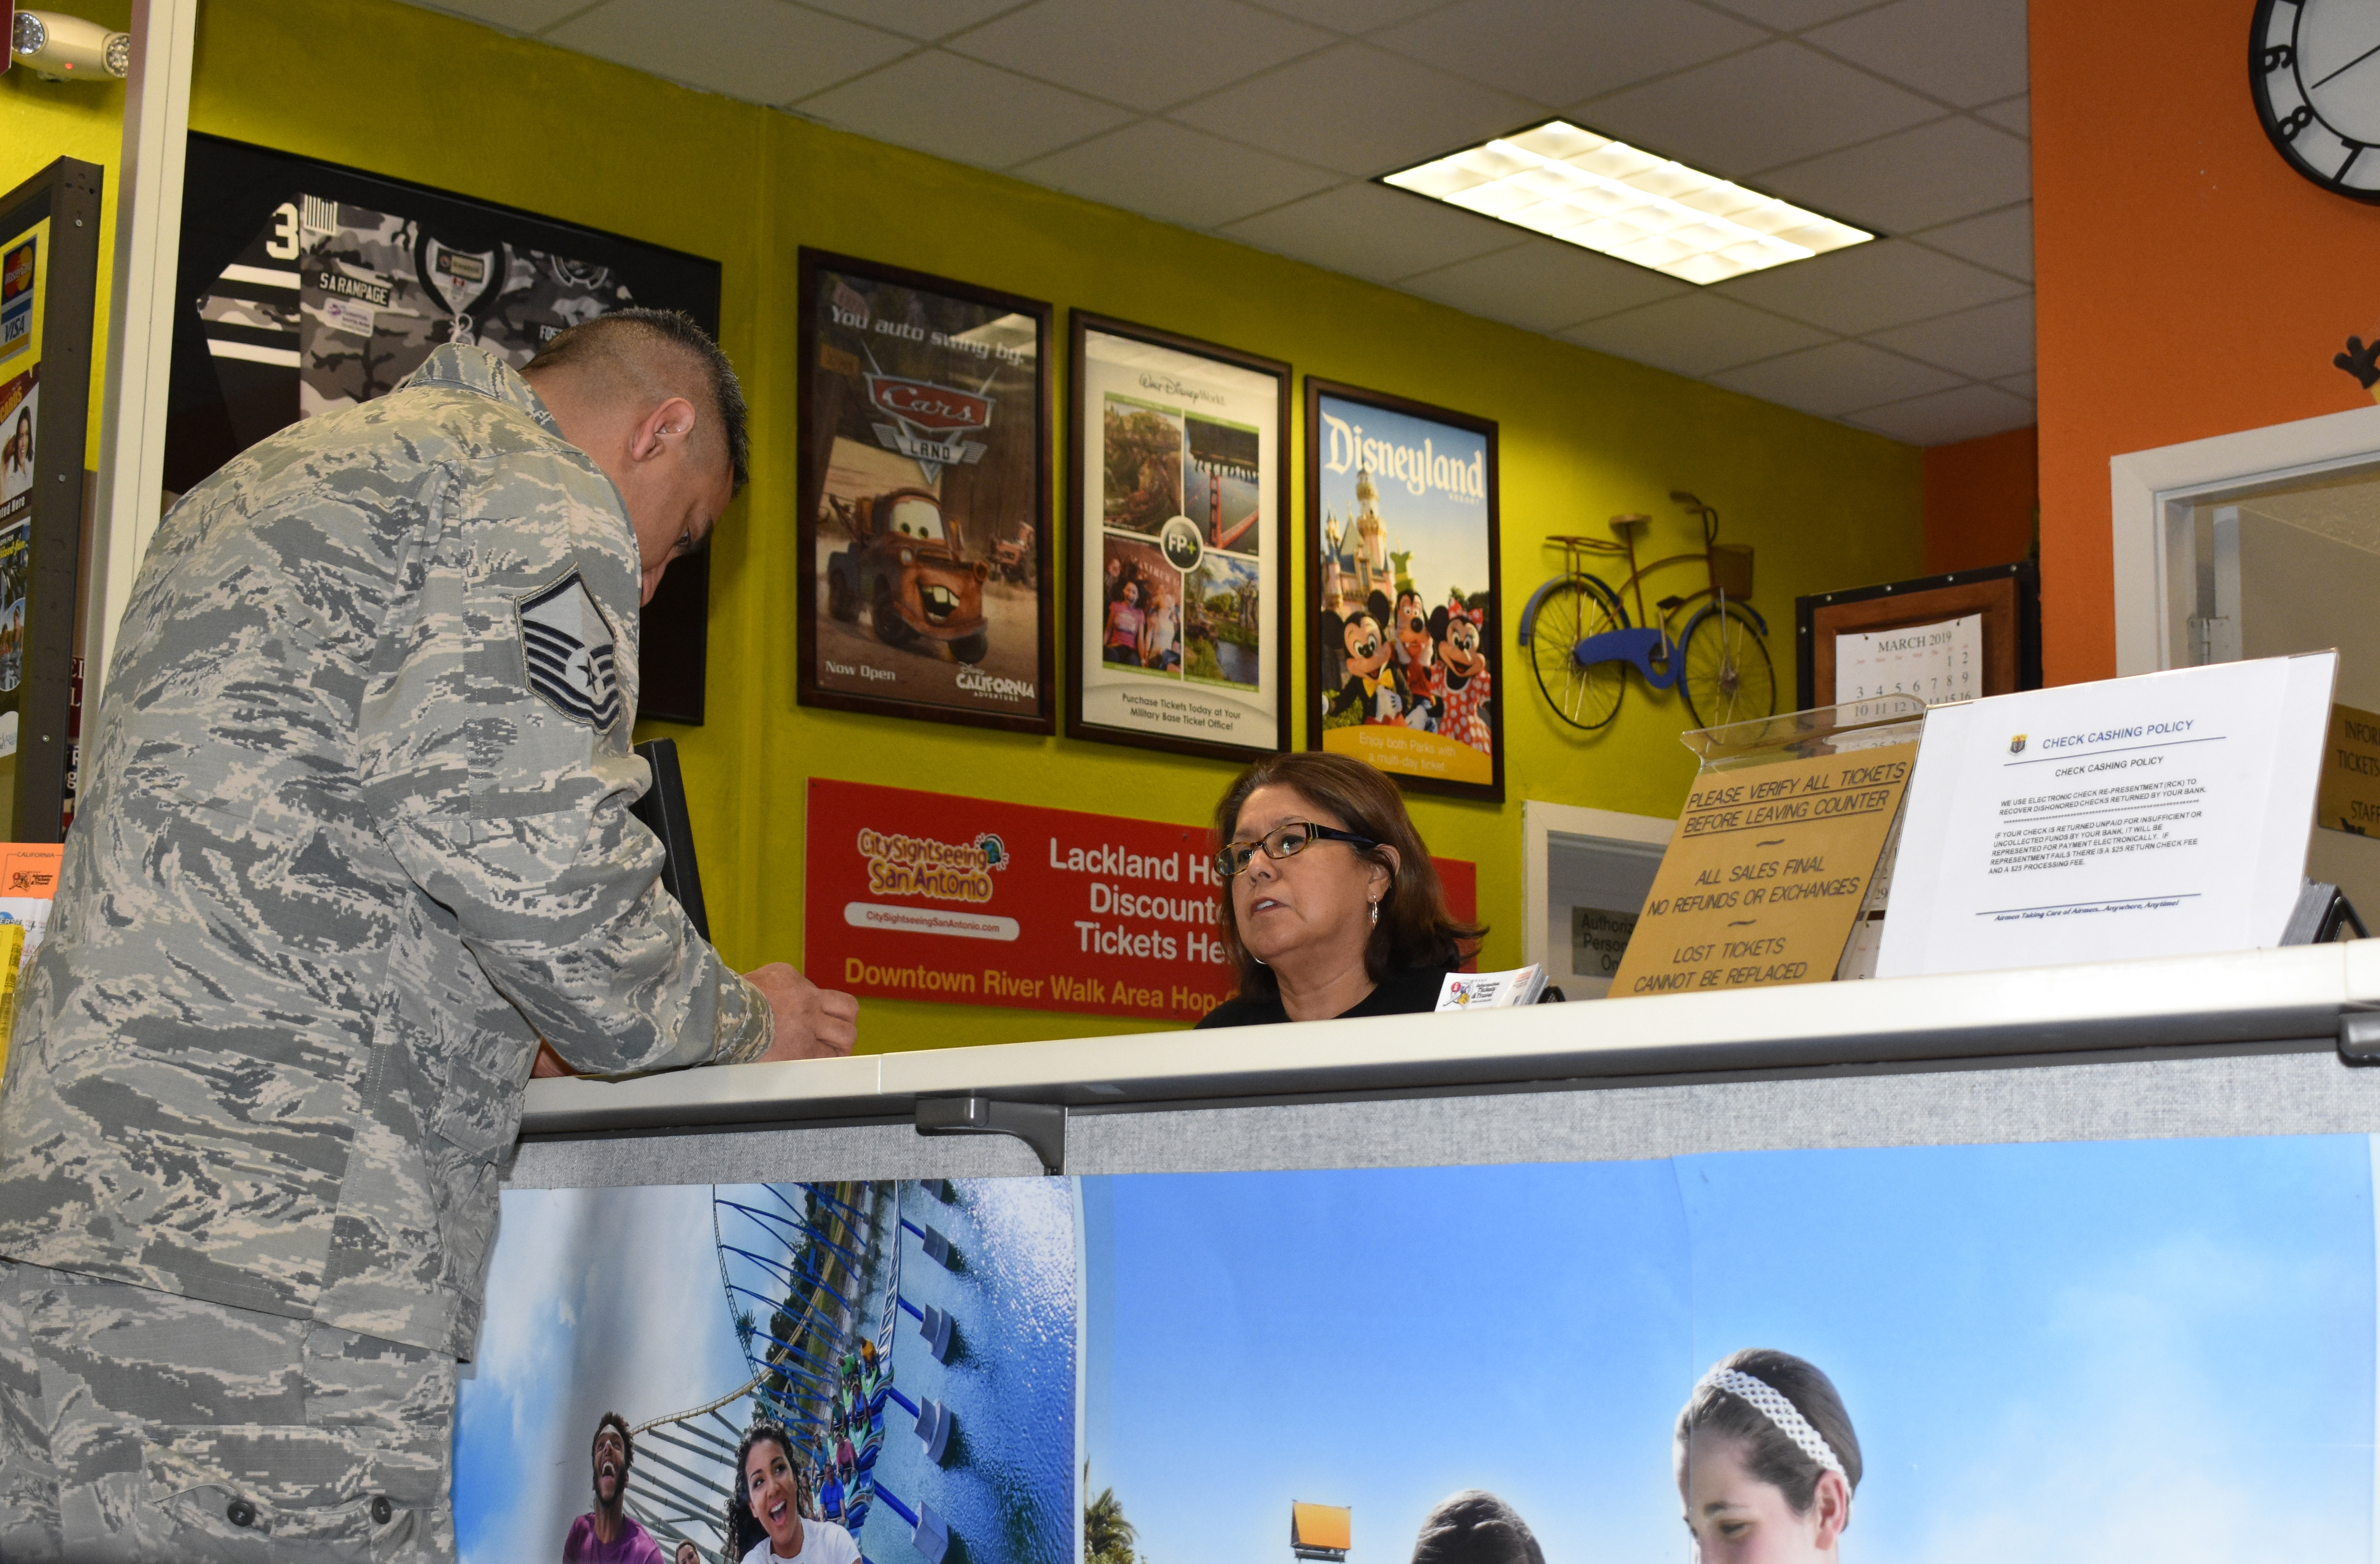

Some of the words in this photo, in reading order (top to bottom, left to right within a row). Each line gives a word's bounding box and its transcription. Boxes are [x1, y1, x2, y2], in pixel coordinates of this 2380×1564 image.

[2276, 106, 2313, 142] 8
[266, 202, 299, 260] 3
[5, 315, 25, 342] VISA
[832, 305, 869, 329] You
[875, 319, 924, 342] auto
[930, 331, 989, 359] swing
[995, 343, 1024, 366] by.
[883, 385, 976, 424] Cars
[910, 439, 950, 460] LAND
[1322, 410, 1484, 498] Disneyland
[1168, 534, 1196, 555] FP+
[1878, 637, 1926, 653] MARCH
[1929, 631, 1952, 646] 2019
[826, 660, 855, 675] Now
[861, 664, 896, 681] Open
[1962, 652, 1968, 663] 2
[956, 673, 1035, 699] CALIFORNIA
[1856, 686, 1863, 699] 3
[1876, 685, 1883, 695] 4
[1896, 682, 1901, 693] 5
[1913, 680, 1920, 692] 6
[1931, 677, 1937, 689] 7
[1947, 675, 1952, 686] 8
[1962, 672, 1968, 683] 9
[1122, 693, 1158, 706] Purchase
[1160, 699, 1186, 711] Tickets
[1189, 703, 1212, 716] Today
[1225, 709, 1241, 719] Your
[1130, 707, 1159, 720] Military
[1162, 712, 1181, 722] Base
[1184, 715, 1205, 725] Ticket
[1207, 719, 1233, 730] Office!
[1855, 705, 1868, 717] 10
[1876, 703, 1886, 714] 11
[1894, 702, 1905, 712] 12
[1360, 732, 1384, 749] Enjoy
[1387, 737, 1407, 749] both
[1410, 739, 1436, 754] Parks
[1438, 745, 1456, 757] with
[2042, 734, 2085, 749] CHECK
[2088, 726, 2143, 743] CASHING
[2146, 719, 2193, 735] POLICY
[1377, 754, 1418, 770] multi-day
[2055, 766, 2085, 777] CHECK
[2087, 760, 2127, 772] CASHING
[2130, 756, 2164, 767] POLICY
[2337, 749, 2380, 777] TICKETS
[1687, 786, 1744, 809] PLEASE
[1749, 778, 1801, 799] VERIFY
[1803, 774, 1829, 790] ALL
[1841, 761, 1907, 785] TICKETS
[2028, 793, 2072, 804] ELECTRONIC
[2073, 789, 2097, 798] CHECK
[2098, 782, 2163, 795] RE-PRESENTMENT
[2164, 780, 2184, 789] (RCK)
[1684, 810, 1742, 833] BEFORE
[1745, 802, 1808, 824] LEAVING
[1814, 790, 1890, 815] COUNTER
[1999, 807, 2032, 815] RECOVER
[2033, 801, 2079, 812] DISHONORED
[2080, 797, 2109, 806] CHECKS
[2110, 793, 2149, 802] RETURNED
[2184, 786, 2207, 795] BANK.
[2023, 827, 2047, 836] CHECK
[2056, 822, 2095, 832] RETURNED
[2095, 820, 2122, 828] UNPAID
[2140, 812, 2190, 823] INSUFFICIENT
[860, 831, 988, 870] CitySightseeing
[1990, 853, 2050, 865] REPRESENTMENT
[2072, 848, 2095, 857] THERE
[2125, 842, 2155, 851] RETURN
[2156, 839, 2182, 848] CHECK
[1992, 845, 2042, 856] REPRESENTED
[2058, 840, 2091, 850] PAYMENT
[2093, 833, 2158, 845] ELECTRONICALLY.
[1994, 836, 2044, 847] UNCOLLECTED
[2045, 833, 2068, 842] FUNDS
[1050, 837, 1178, 882] Lackland
[1189, 854, 1223, 887] He
[1695, 870, 1721, 886] ALL
[1729, 861, 1778, 882] SALES
[1783, 856, 1825, 875] FINAL
[2023, 861, 2069, 870] PROCESSING
[872, 861, 911, 891] San
[913, 866, 990, 900] Antonio
[1646, 900, 1669, 916] NO
[1672, 891, 1737, 914] REFUNDS
[1743, 888, 1766, 905] OR
[1769, 877, 1861, 903] EXCHANGES
[2144, 899, 2179, 909] Anytime!
[866, 910, 1000, 933] CitySightseeingSanAntonio.com
[1582, 913, 1634, 934] Authoriz
[1075, 921, 1177, 959] Tickets
[1188, 931, 1226, 964] He
[1584, 933, 1627, 951] Person
[1673, 944, 1715, 964] LOST
[1722, 937, 1787, 959] TICKETS
[1601, 954, 1619, 971] On
[845, 957, 975, 993] Downtown
[984, 970, 1044, 998] River
[1051, 975, 1105, 1003] Walk
[1112, 981, 1164, 1008] Area
[1634, 971, 1696, 993] CANNOT
[1699, 969, 1723, 987] BE
[1725, 961, 1807, 985] REPLACED
